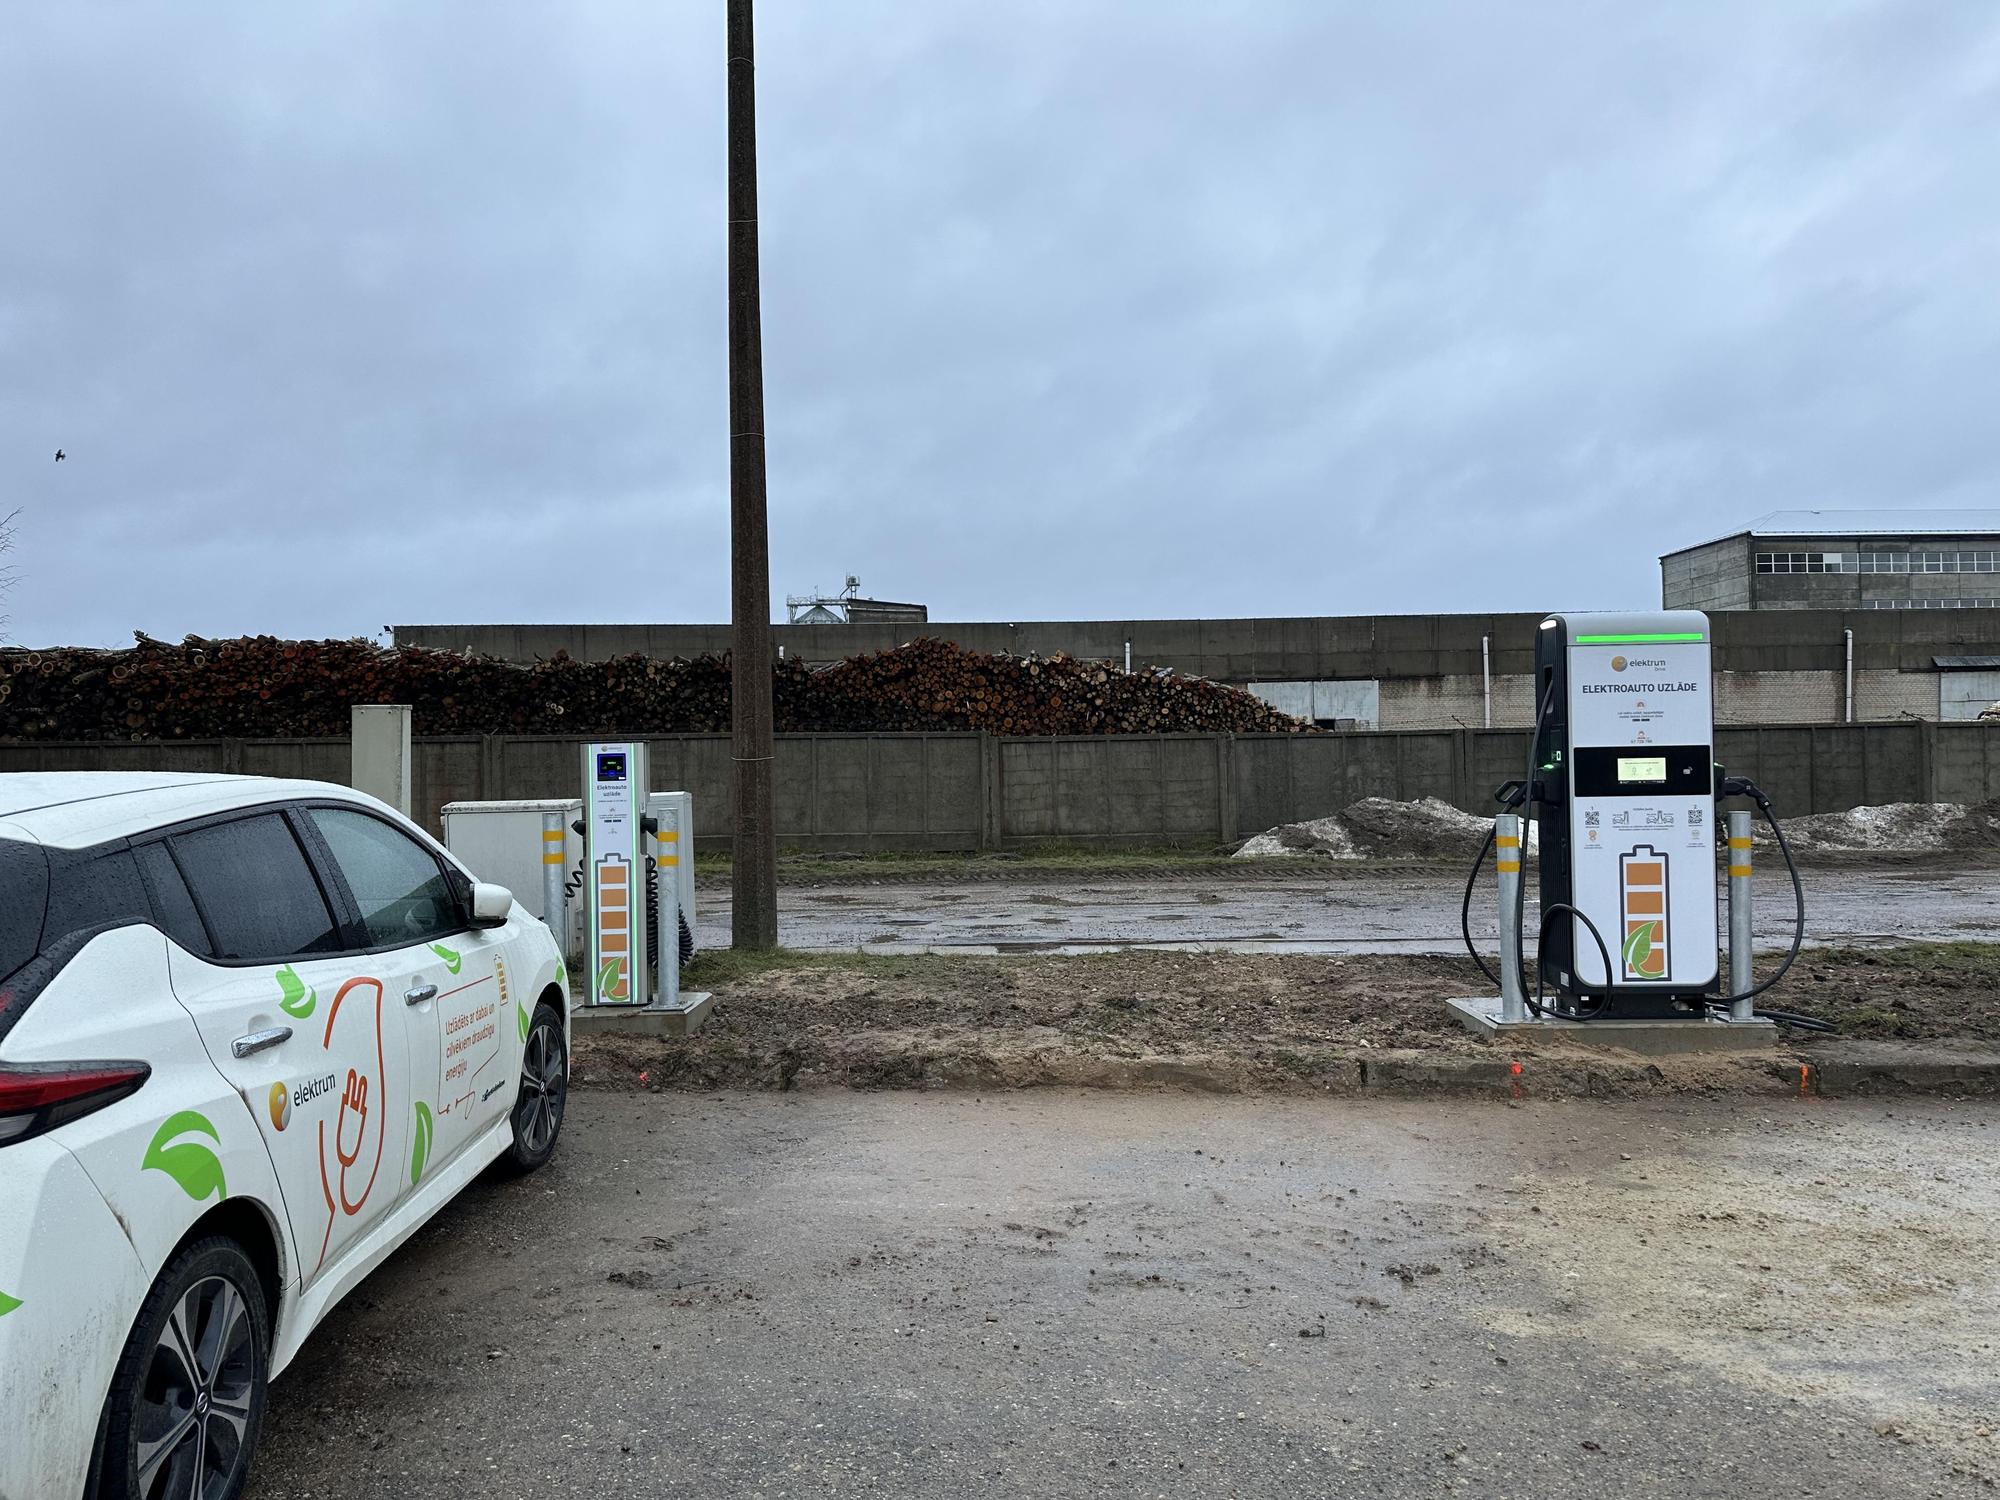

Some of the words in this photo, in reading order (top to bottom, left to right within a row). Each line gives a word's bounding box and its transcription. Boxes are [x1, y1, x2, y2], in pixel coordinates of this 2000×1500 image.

[1629, 659, 1666, 667] elektrum
[1582, 683, 1655, 694] ELEKTROAUTO
[1657, 681, 1697, 692] UZLĀDE
[445, 1014, 469, 1035] Uzlādēts
[469, 1012, 475, 1024] ar
[475, 1004, 488, 1021] dabai
[488, 1003, 495, 1015] un
[446, 1037, 472, 1058] cilvēkiem
[472, 1023, 495, 1044] draudzīgu
[445, 1058, 468, 1081] enerģiju
[293, 1073, 336, 1107] elektrum
